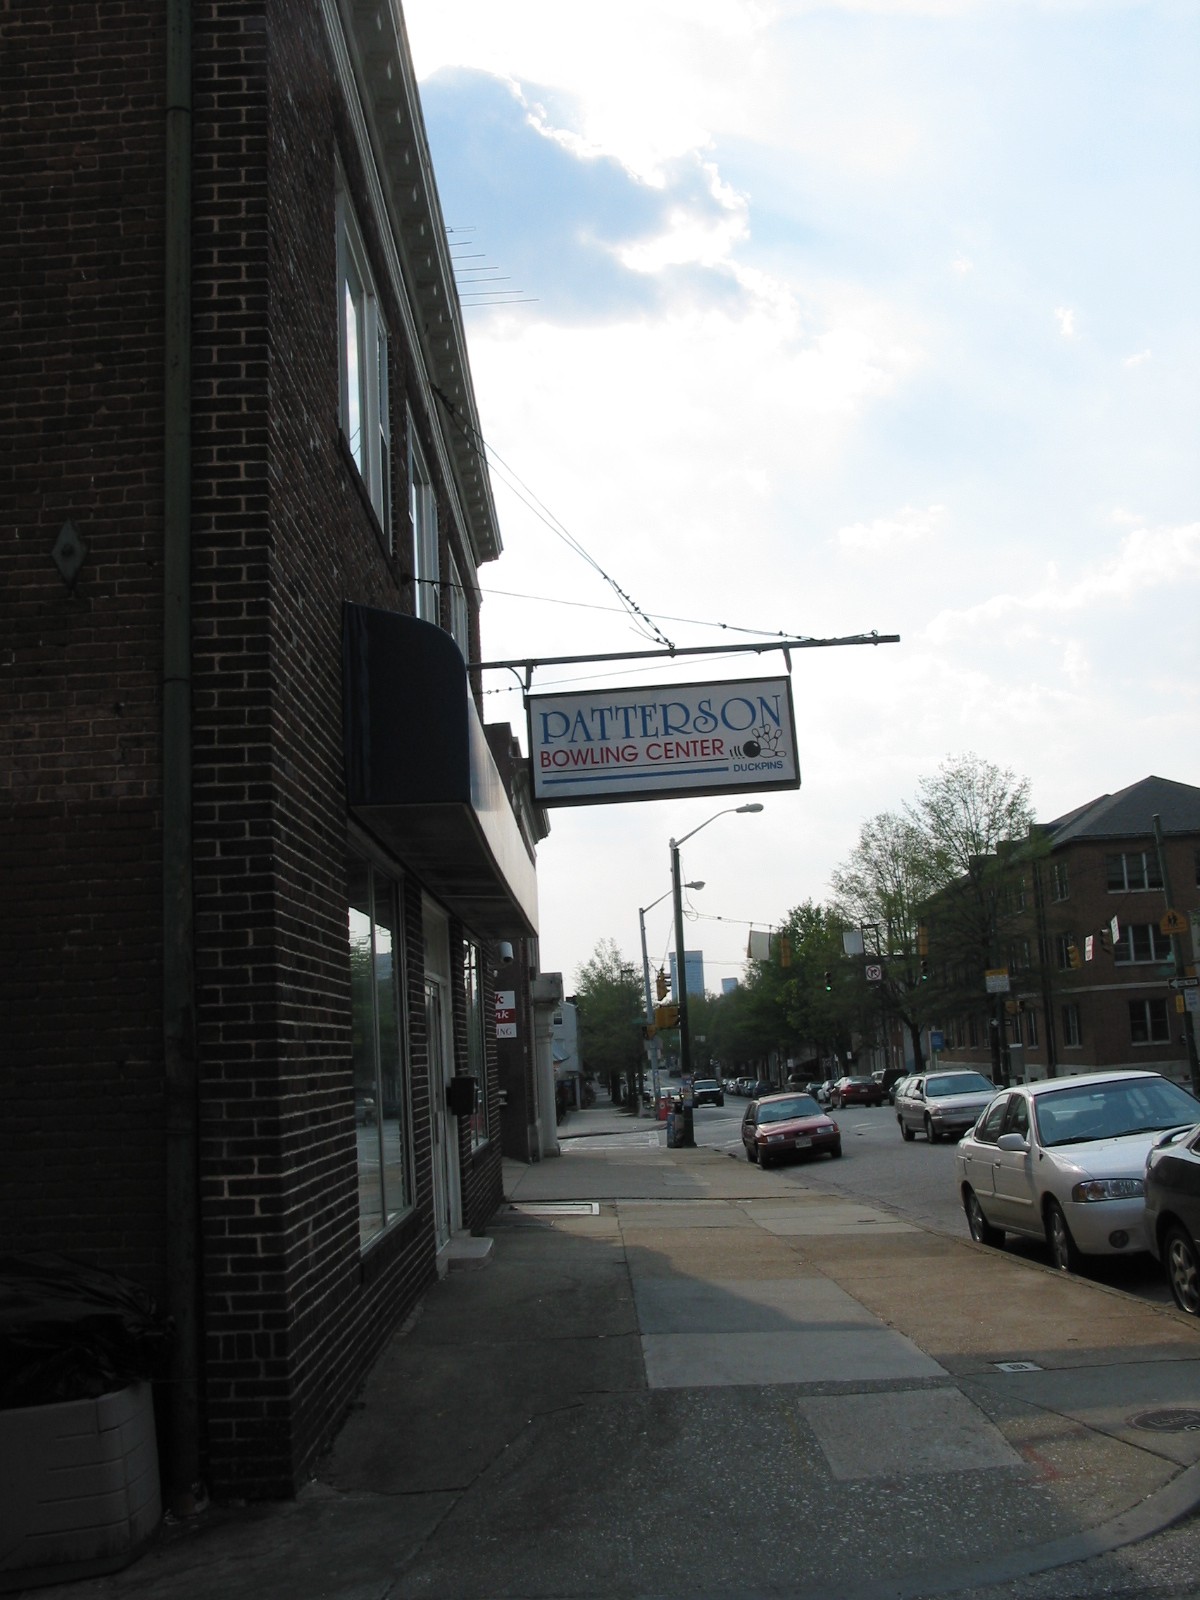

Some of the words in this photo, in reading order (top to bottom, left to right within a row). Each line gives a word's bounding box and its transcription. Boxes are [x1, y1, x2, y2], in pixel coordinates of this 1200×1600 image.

[539, 694, 781, 745] PATTERSON
[540, 744, 639, 768] BOWLING
[645, 738, 724, 761] CENTER
[733, 760, 784, 773] DUCKPINS
